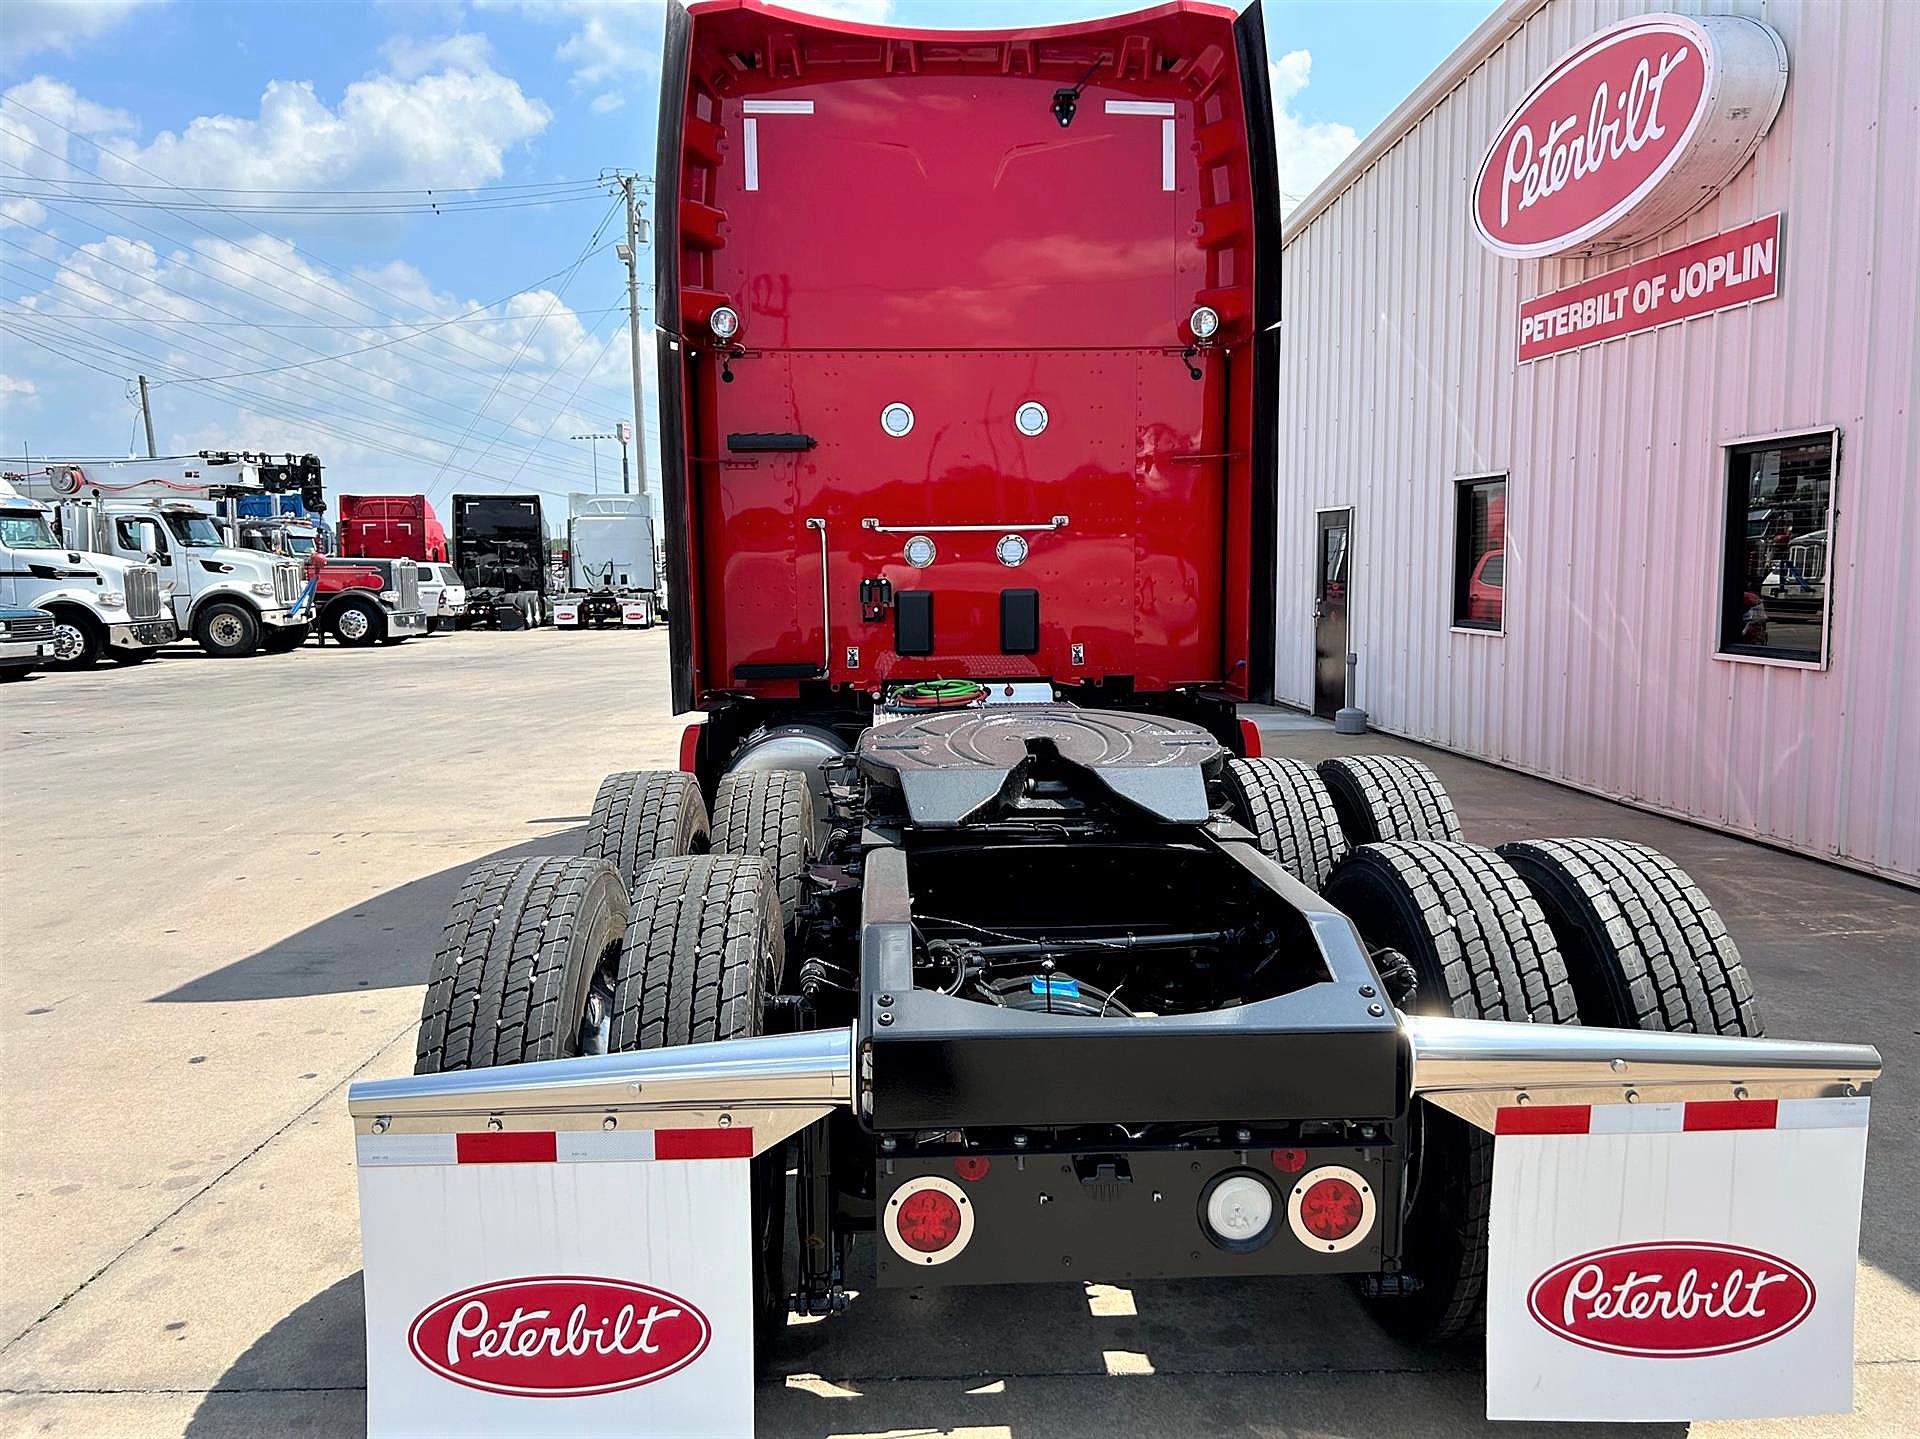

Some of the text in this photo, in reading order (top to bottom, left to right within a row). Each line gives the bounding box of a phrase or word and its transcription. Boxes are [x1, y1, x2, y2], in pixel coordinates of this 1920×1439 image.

[1501, 47, 1687, 227] Peterbilt
[1521, 238, 1774, 345] PETERBILT OF JOPLIN
[447, 1301, 681, 1365] Peterbilt
[1563, 1264, 1789, 1326] Peterbilt
